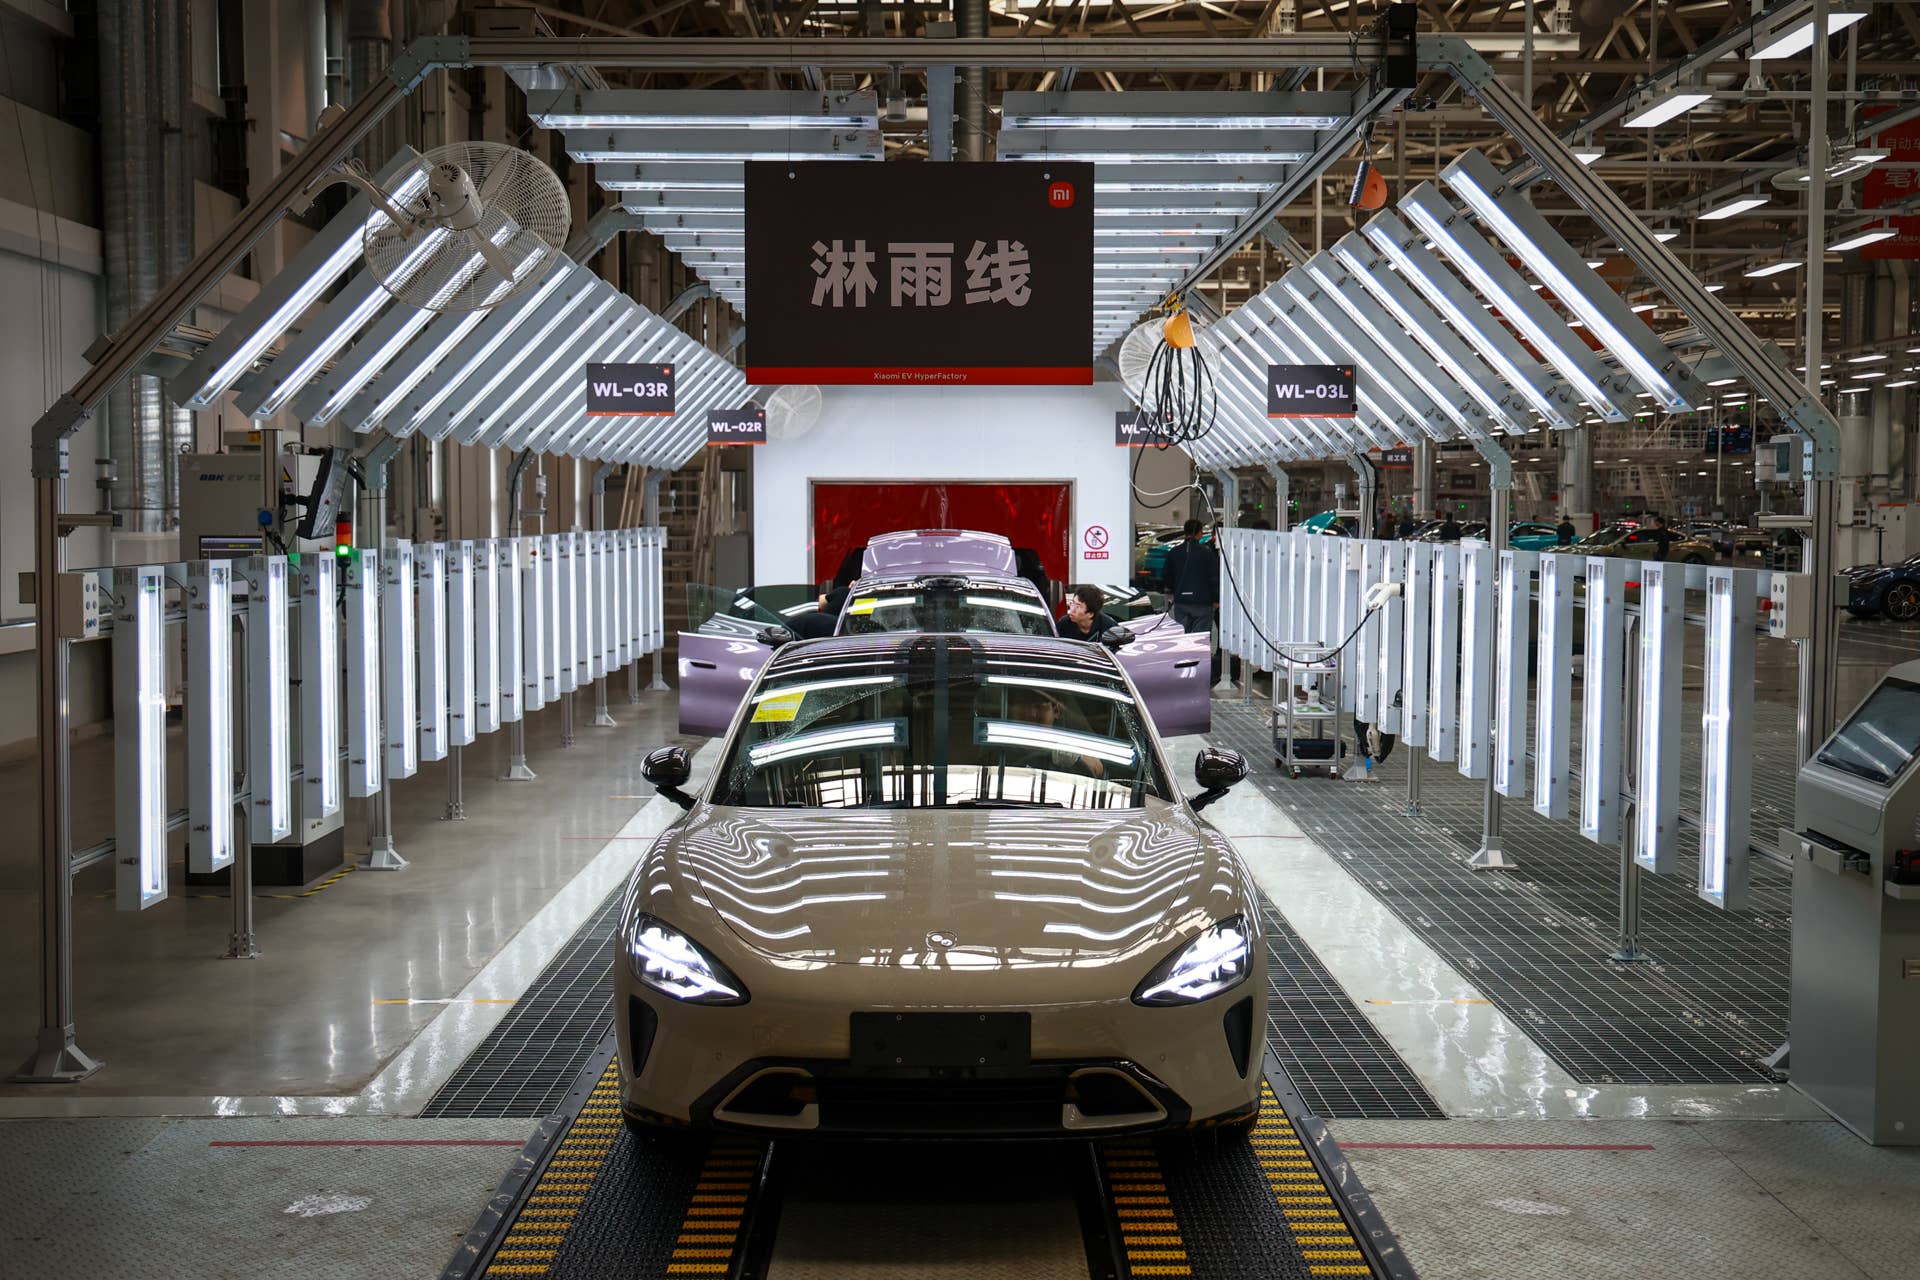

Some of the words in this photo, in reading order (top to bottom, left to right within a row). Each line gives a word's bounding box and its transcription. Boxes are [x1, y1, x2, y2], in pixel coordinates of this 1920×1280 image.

[810, 239, 1032, 308] 淋雨线
[873, 372, 900, 380] Xiaomi
[901, 372, 913, 380] EV
[914, 372, 968, 381] HyperFactory
[593, 382, 669, 398] WL-03R
[1275, 384, 1349, 399] WL-03L
[711, 422, 762, 433] WL-02R
[1120, 424, 1170, 434] WL-L
